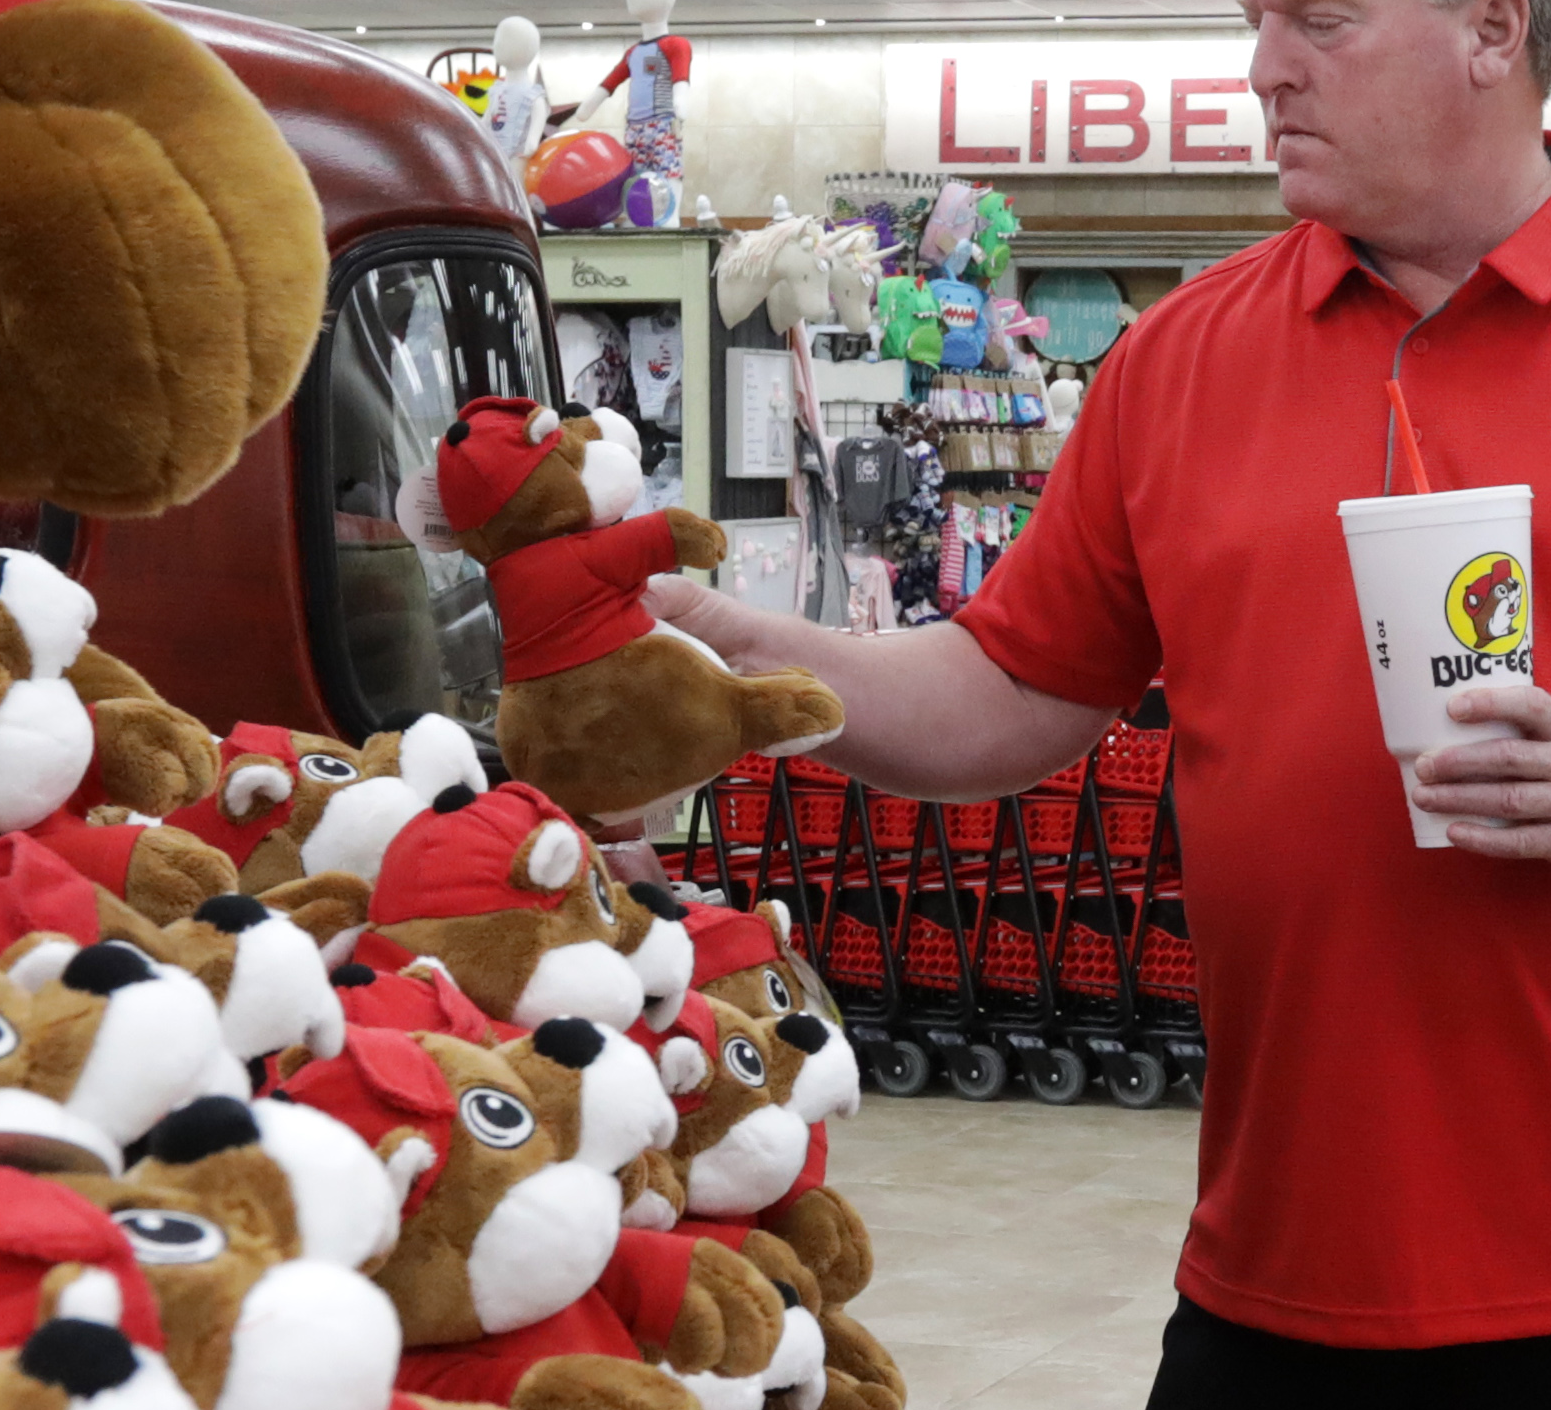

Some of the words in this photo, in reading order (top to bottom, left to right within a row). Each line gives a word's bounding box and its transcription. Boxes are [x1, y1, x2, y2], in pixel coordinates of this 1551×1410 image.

[939, 58, 1278, 163] LIBE
[1375, 619, 1387, 638] oz
[1377, 642, 1391, 670] 44
